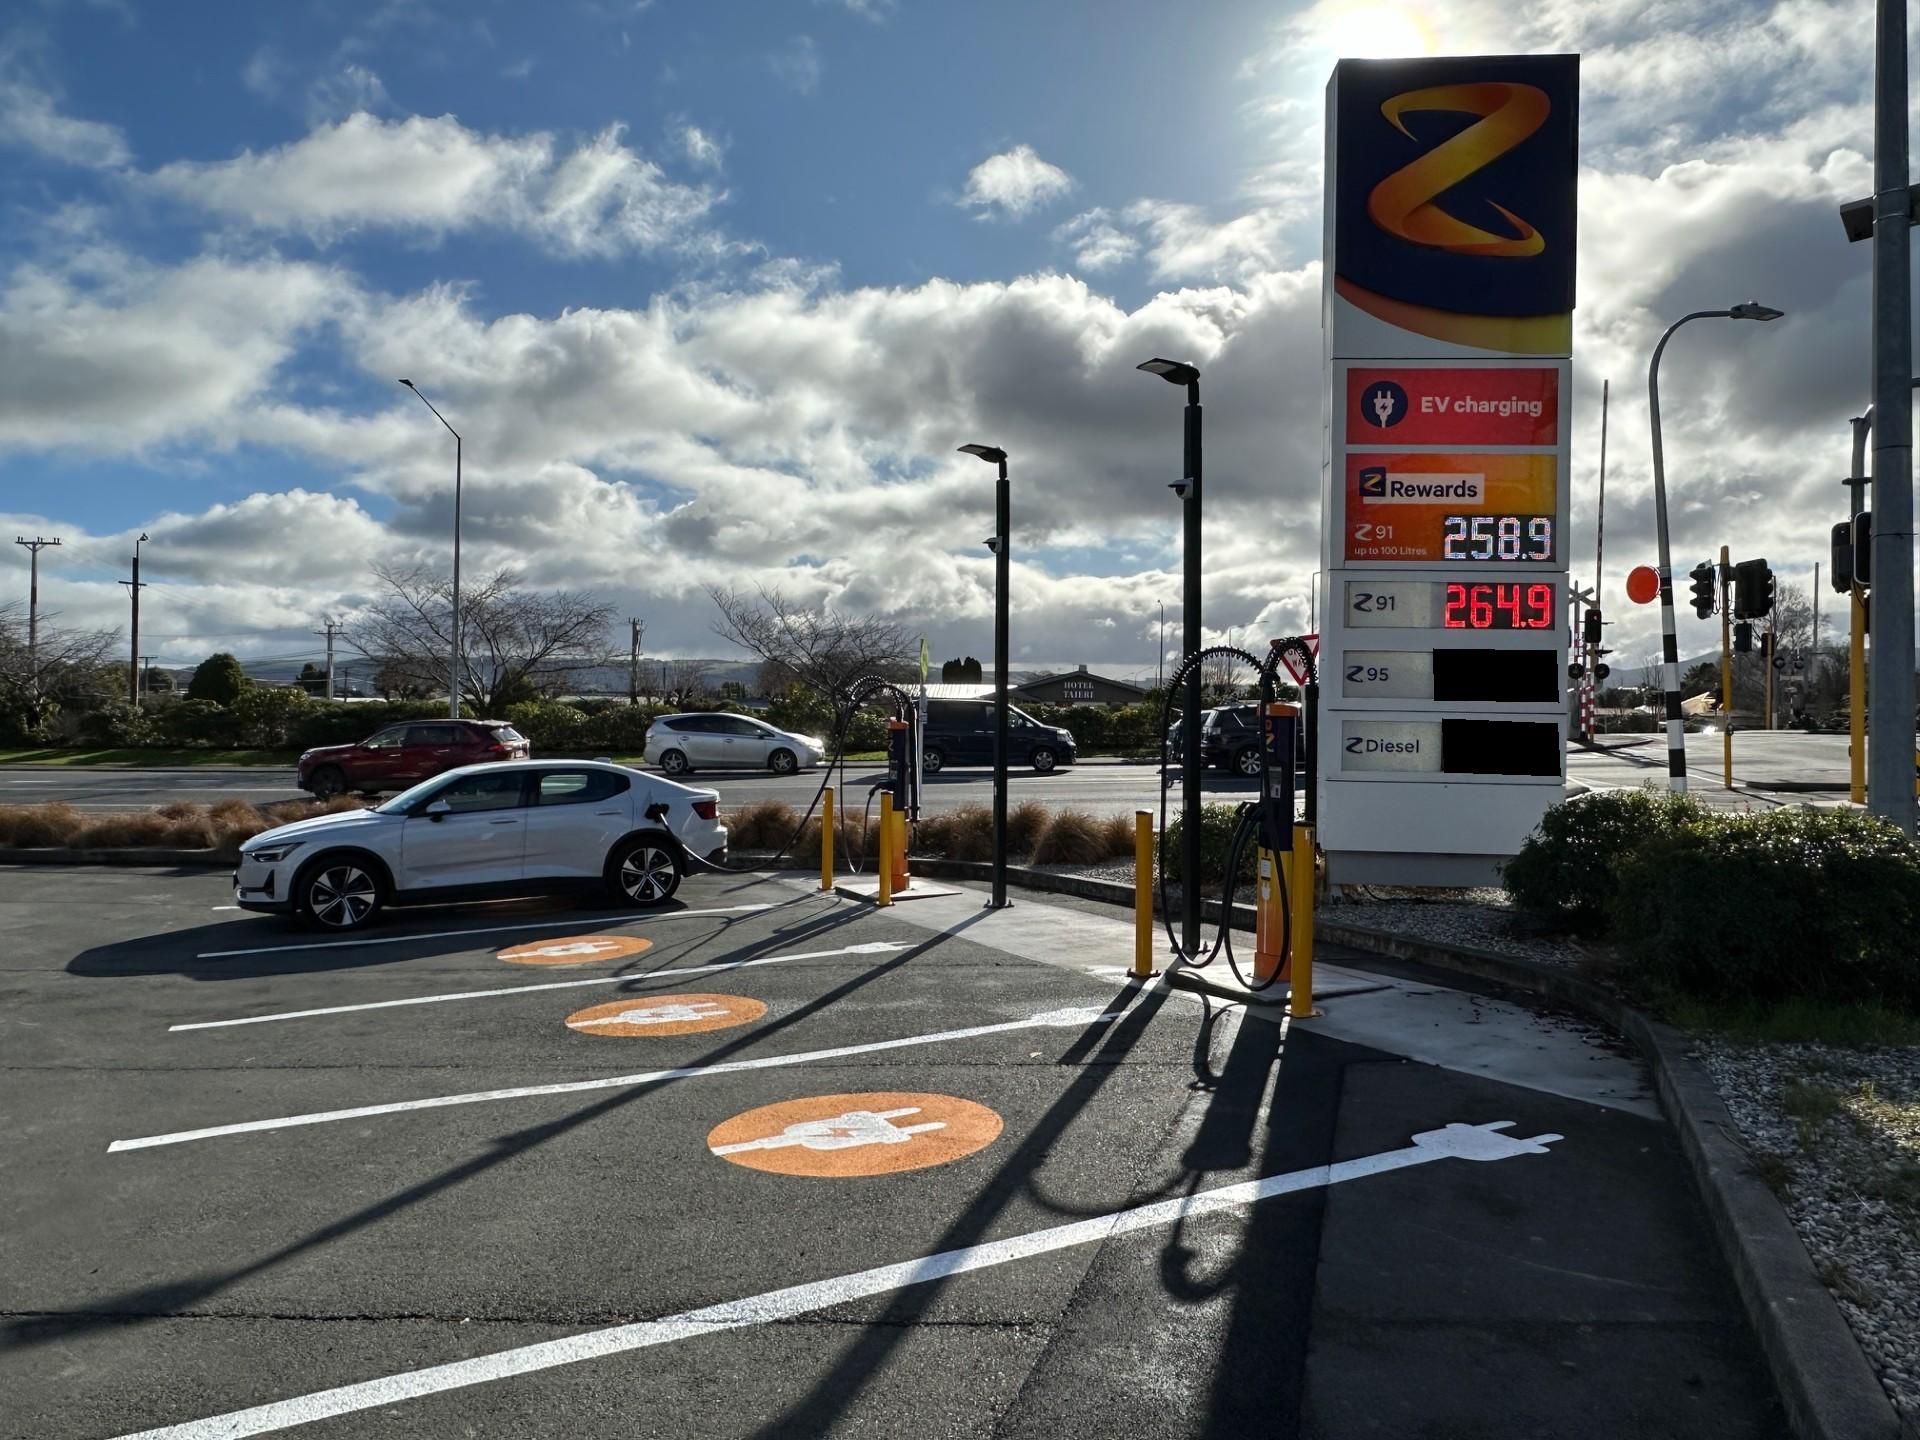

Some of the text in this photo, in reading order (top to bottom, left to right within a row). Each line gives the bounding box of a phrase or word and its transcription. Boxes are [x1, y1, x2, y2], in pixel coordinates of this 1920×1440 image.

[1368, 82, 1552, 257] Z
[1421, 396, 1543, 417] EV charging
[1391, 480, 1478, 498] Rewards
[1375, 525, 1393, 539] 91
[1445, 516, 1551, 560] 258.9
[1354, 546, 1428, 556] up to 100 Litres
[1376, 595, 1395, 611] 91
[1445, 585, 1551, 628] 264.9
[1367, 668, 1390, 682] 95
[1064, 681, 1094, 689] HOTEL
[1064, 690, 1093, 699] TAIERI
[1366, 739, 1420, 753] Diesel
